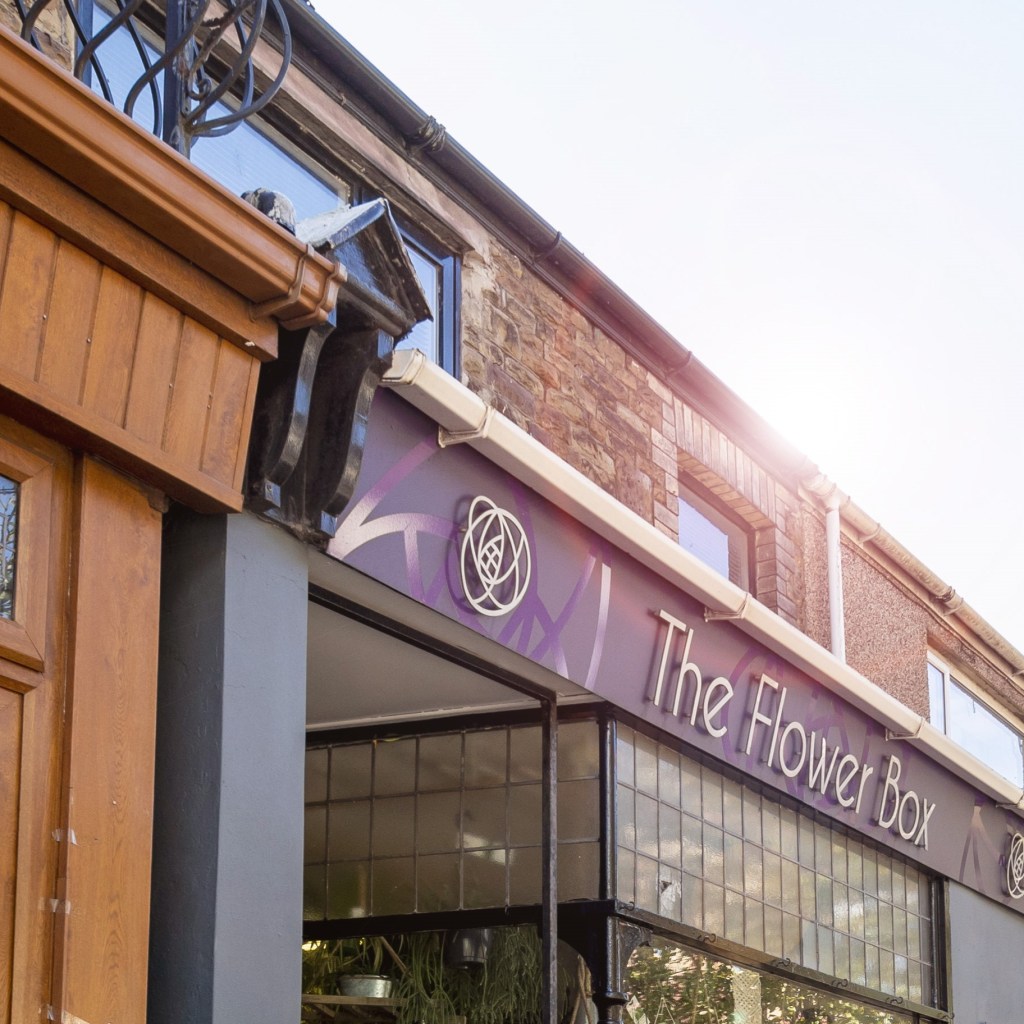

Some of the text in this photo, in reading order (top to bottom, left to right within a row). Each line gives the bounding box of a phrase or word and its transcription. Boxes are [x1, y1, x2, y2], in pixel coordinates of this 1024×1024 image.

[654, 609, 936, 851] The Flower Box
